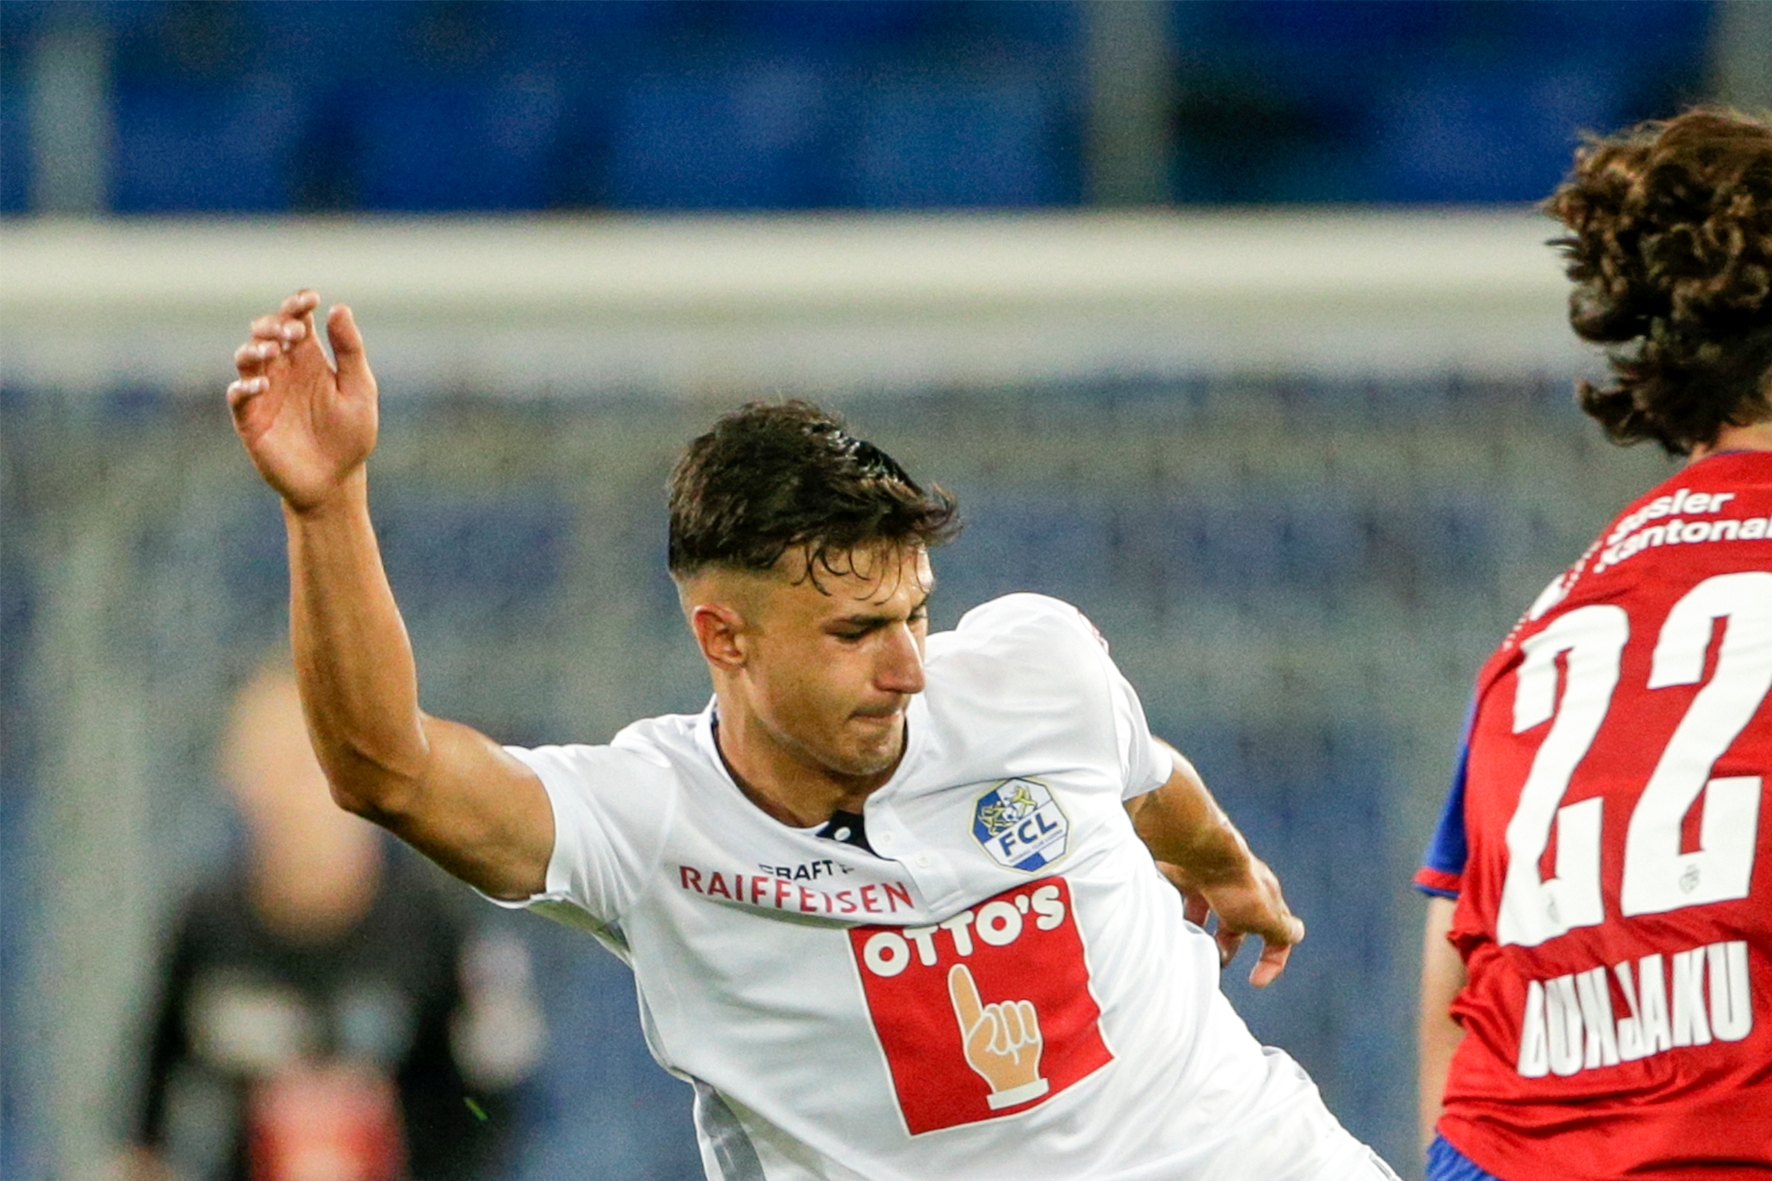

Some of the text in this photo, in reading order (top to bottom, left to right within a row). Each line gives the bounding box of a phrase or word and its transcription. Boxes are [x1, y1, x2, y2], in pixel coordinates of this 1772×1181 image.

[999, 813, 1058, 857] FCL
[679, 865, 915, 913] RAIFFEISEN
[863, 885, 1066, 977] OTTO'S
